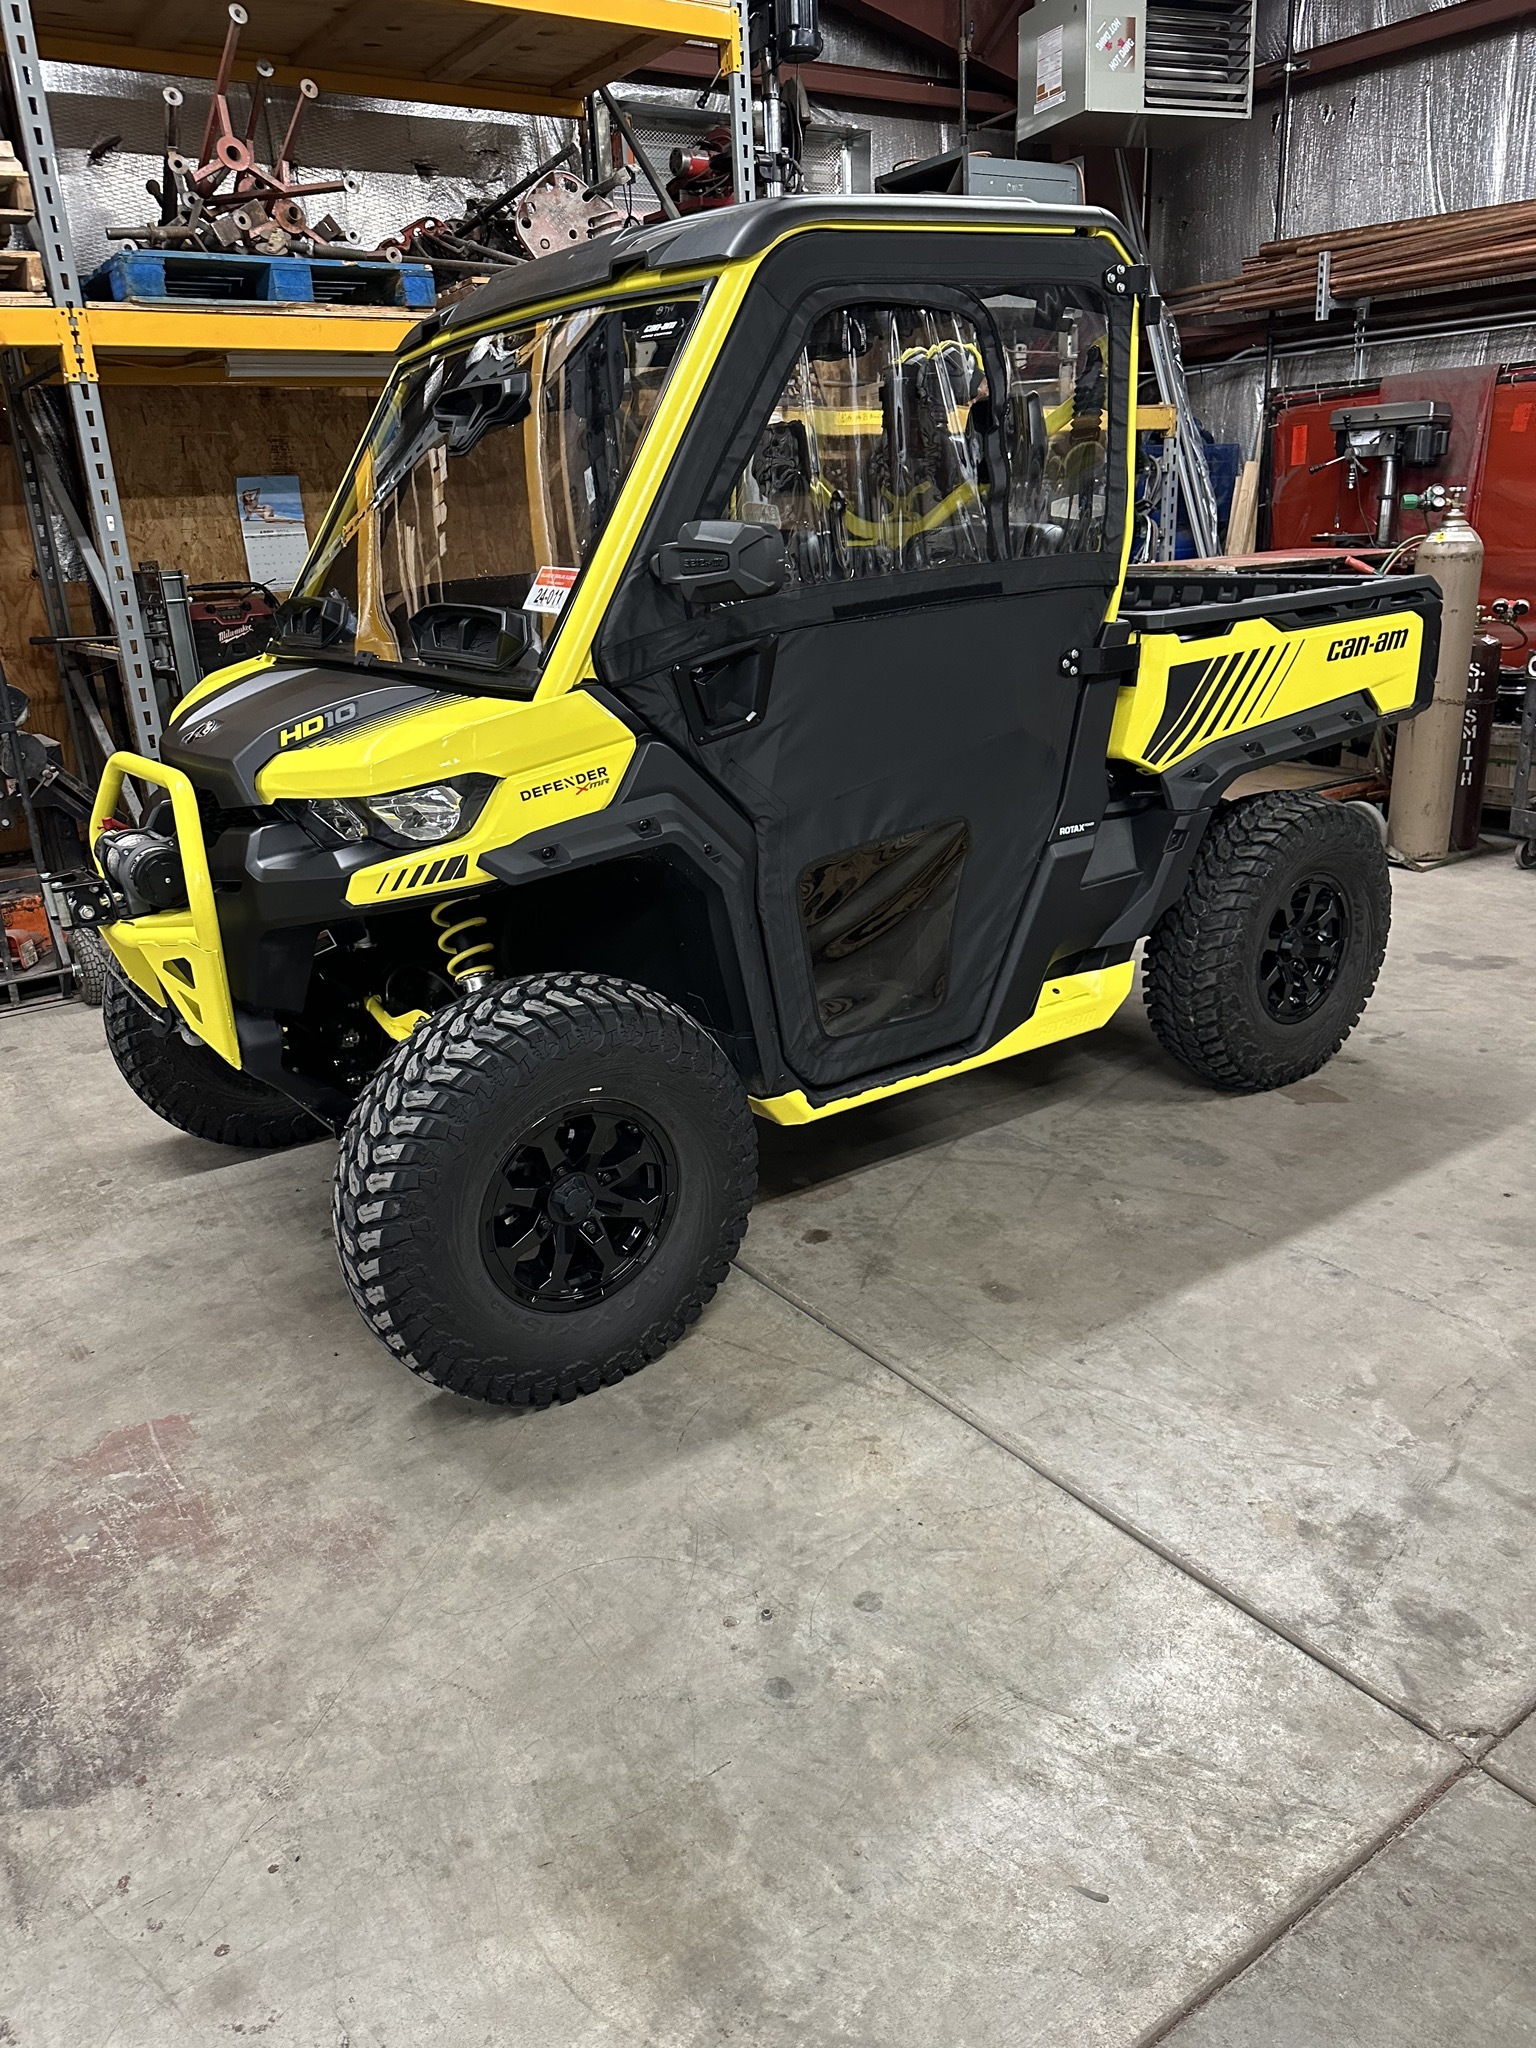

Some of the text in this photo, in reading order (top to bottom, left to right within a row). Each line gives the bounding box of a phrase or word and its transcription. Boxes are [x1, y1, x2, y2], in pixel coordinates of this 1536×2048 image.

[1108, 17, 1122, 36] HOT
[1108, 53, 1122, 72] HOT
[533, 587, 565, 606] 24-011
[218, 624, 254, 643] Milwaukee
[1326, 628, 1409, 662] can-am
[1468, 662, 1486, 678] S.
[280, 702, 357, 748] HD10
[1460, 708, 1478, 786] SMITH
[519, 766, 608, 802] DEFENDER
[1059, 823, 1085, 836] ROTAX
